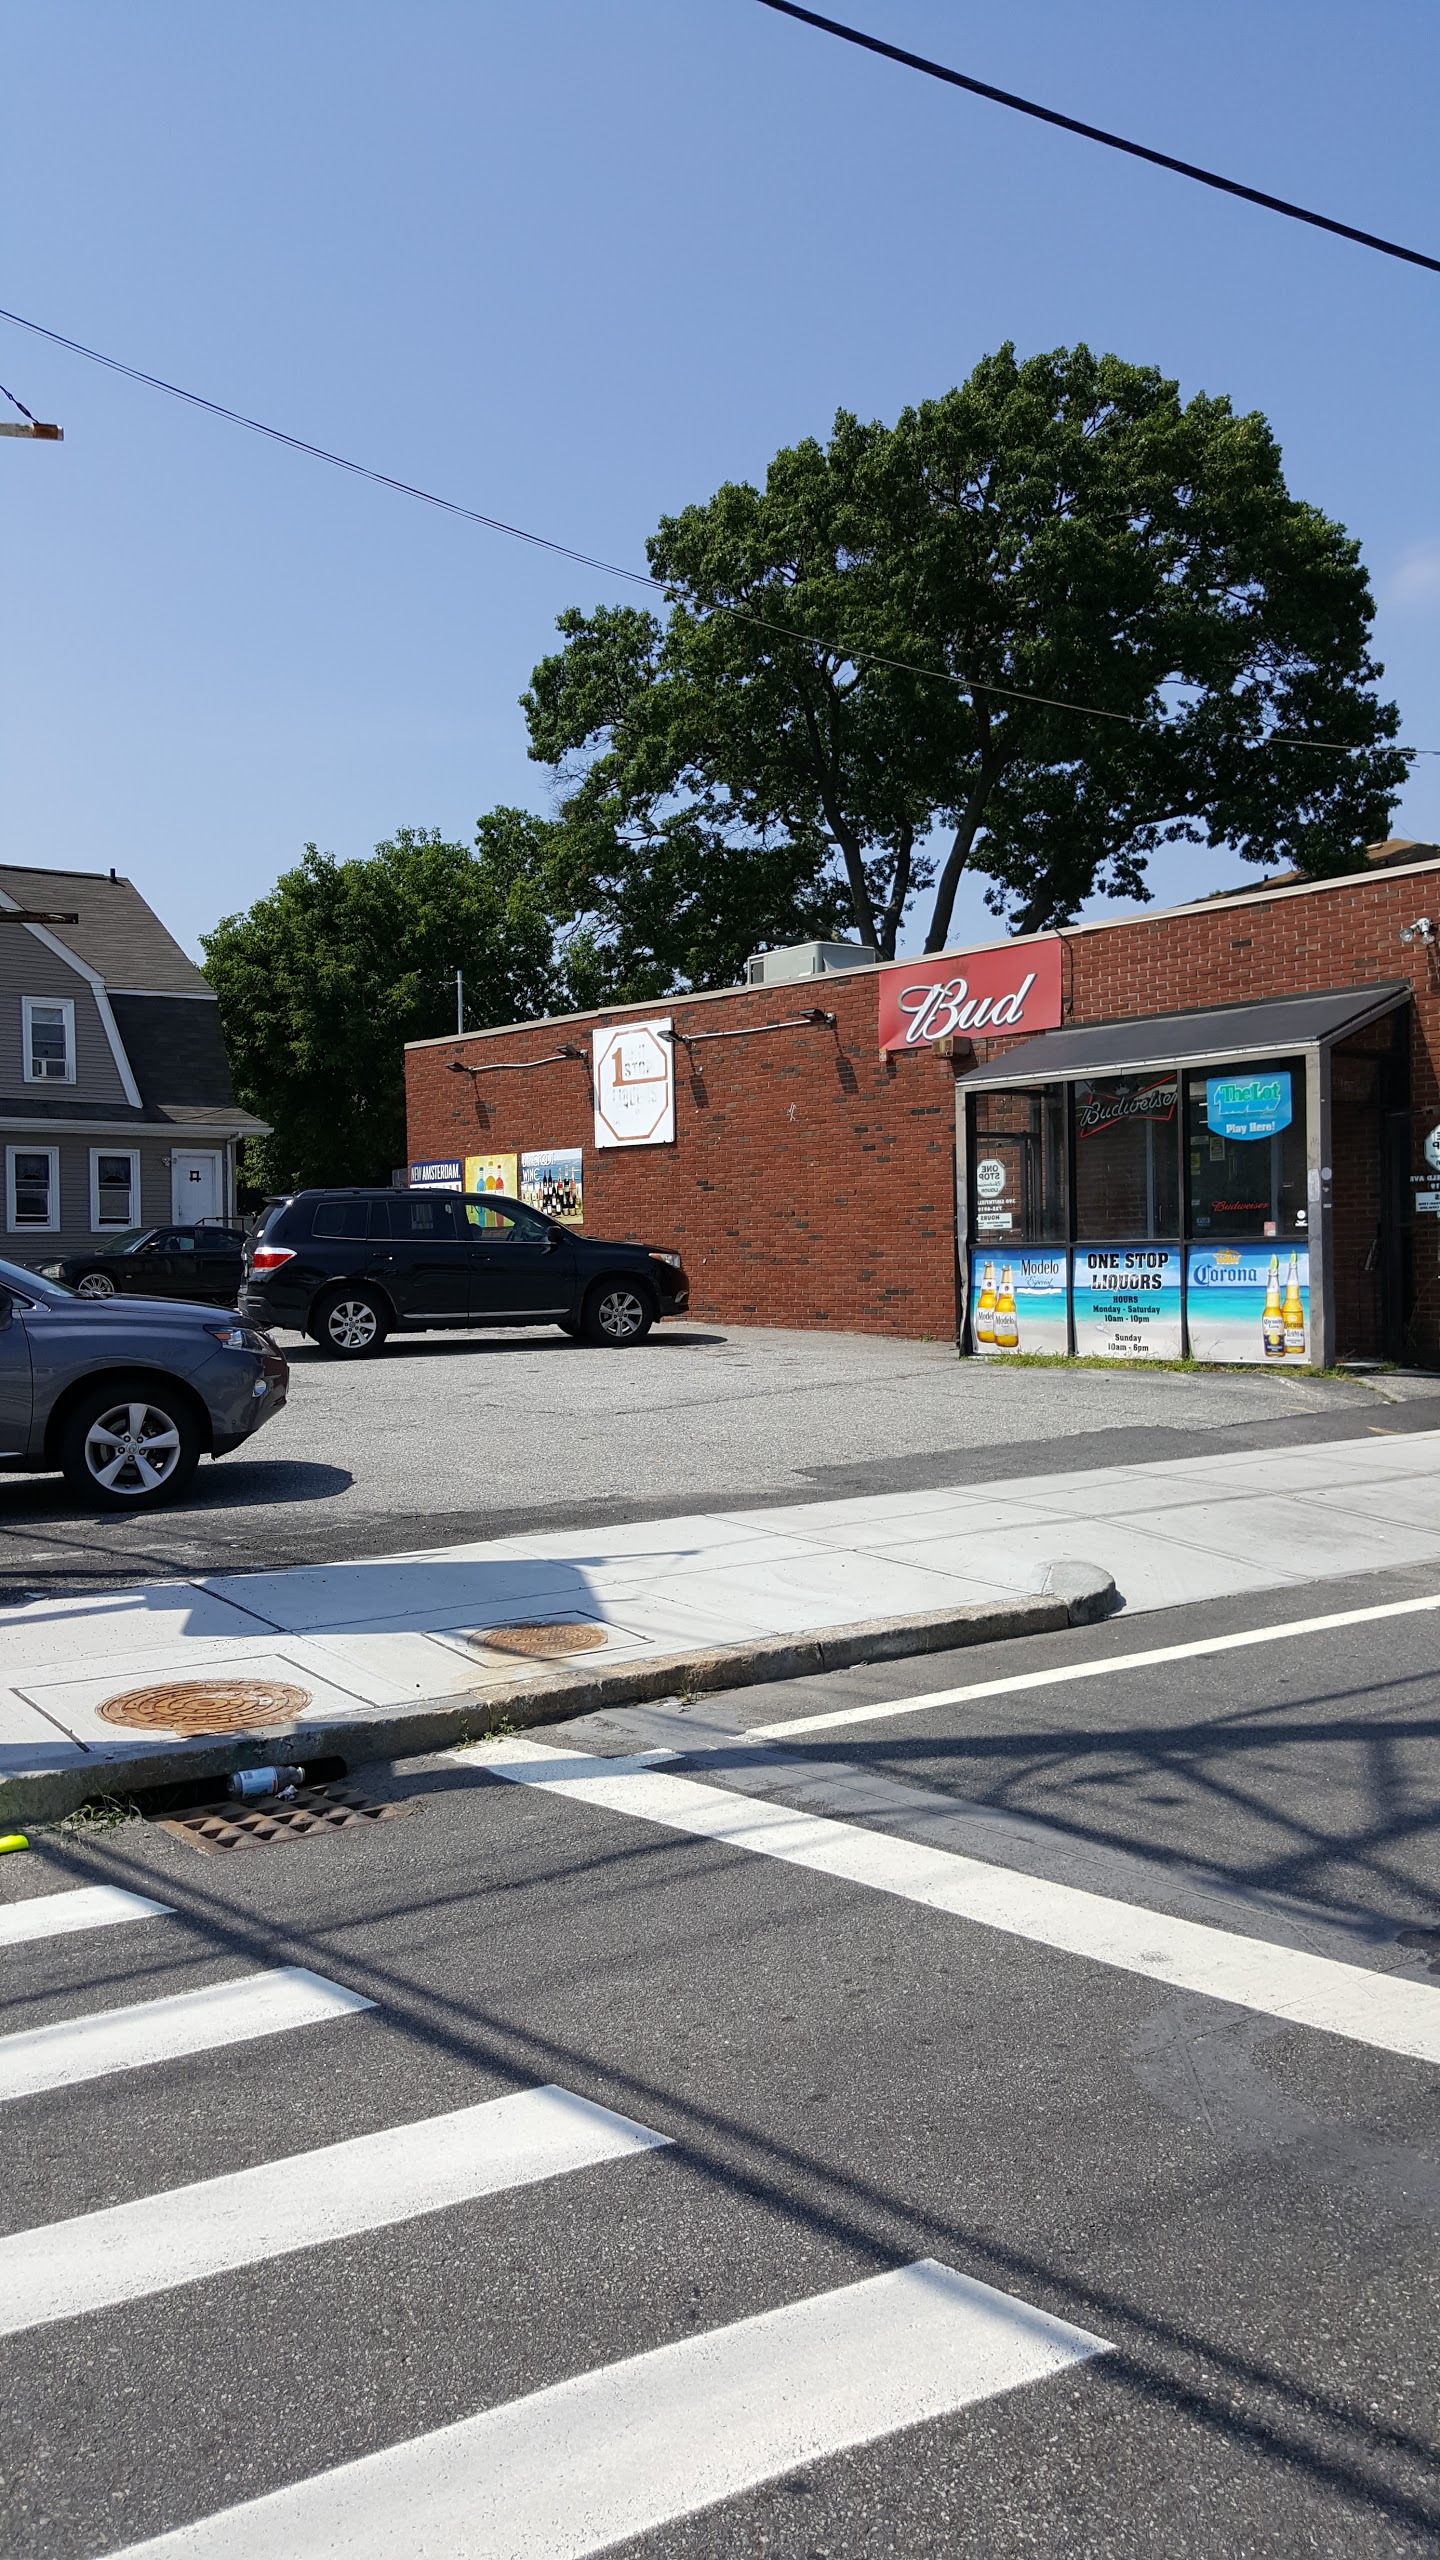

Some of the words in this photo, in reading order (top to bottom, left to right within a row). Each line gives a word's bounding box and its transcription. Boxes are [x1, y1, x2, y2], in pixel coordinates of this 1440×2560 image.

[898, 973, 1037, 1044] Bud
[1075, 1090, 1178, 1127] Budweiser
[1226, 1124, 1247, 1135] Play
[1249, 1121, 1276, 1133] Here!
[411, 1166, 422, 1181] NEW
[522, 1168, 540, 1182] WINE
[1212, 1201, 1271, 1212] Budweiser
[1021, 1259, 1059, 1276] Modelo
[1087, 1253, 1120, 1269] ONE
[1124, 1252, 1169, 1269] STOP
[1091, 1273, 1163, 1291] LIQUORS
[1193, 1264, 1257, 1287] Corona
[979, 1311, 994, 1321] Model
[1093, 1305, 1121, 1314] Monday
[1127, 1305, 1161, 1315] Saturday
[1130, 1315, 1150, 1324] 10pm
[1115, 1334, 1142, 1343] Sunday
[1108, 1343, 1127, 1351] 10am
[1133, 1343, 1149, 1353] 6pm
